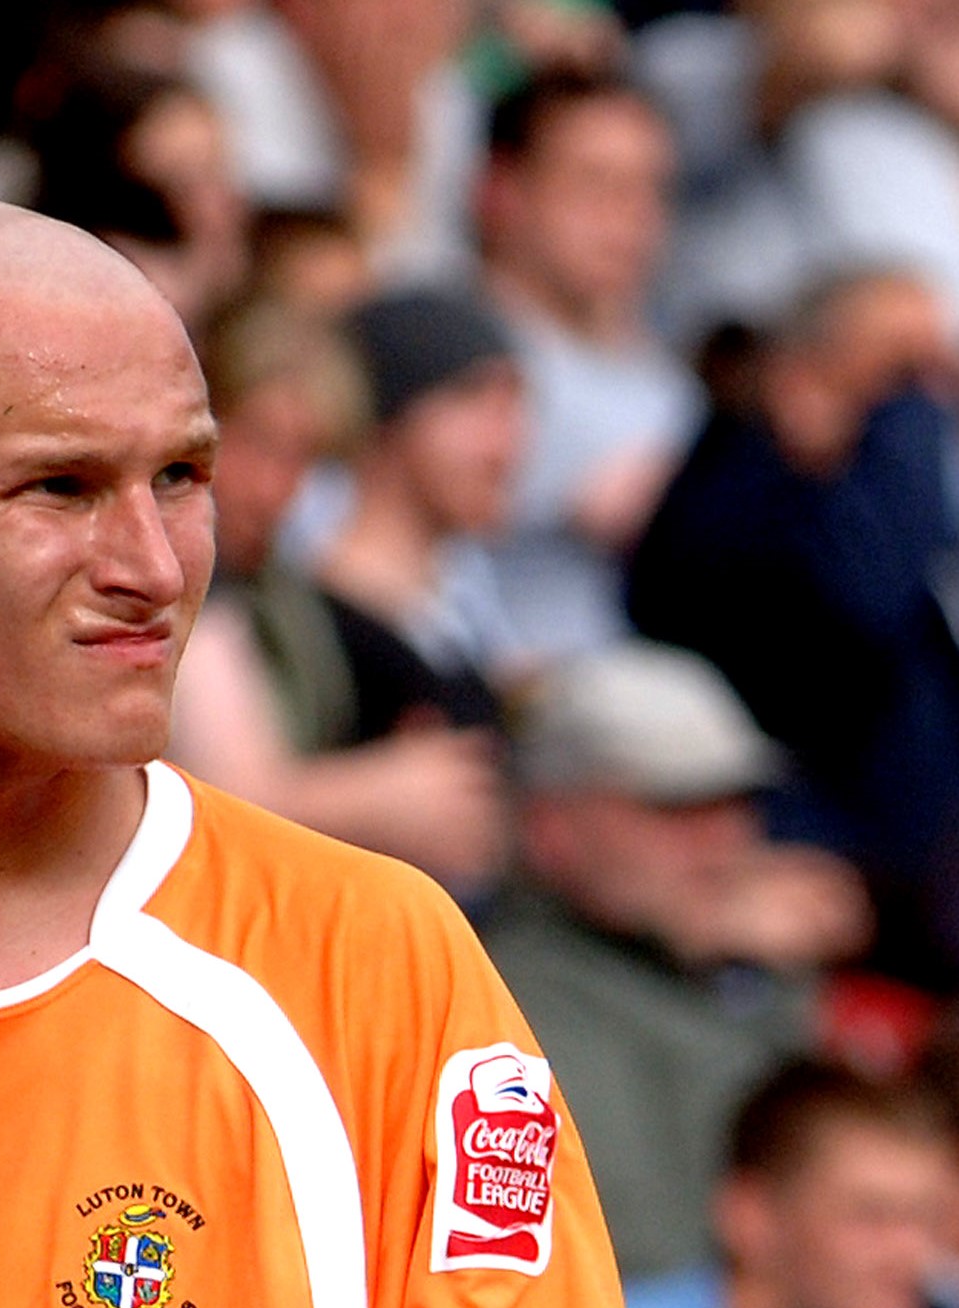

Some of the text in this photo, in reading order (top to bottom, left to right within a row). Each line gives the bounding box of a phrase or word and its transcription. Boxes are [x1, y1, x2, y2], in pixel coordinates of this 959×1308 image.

[467, 1163, 547, 1190] FOOTBALL
[76, 1184, 205, 1231] LUTON TOWN
[466, 1181, 546, 1216] LEAGUE
